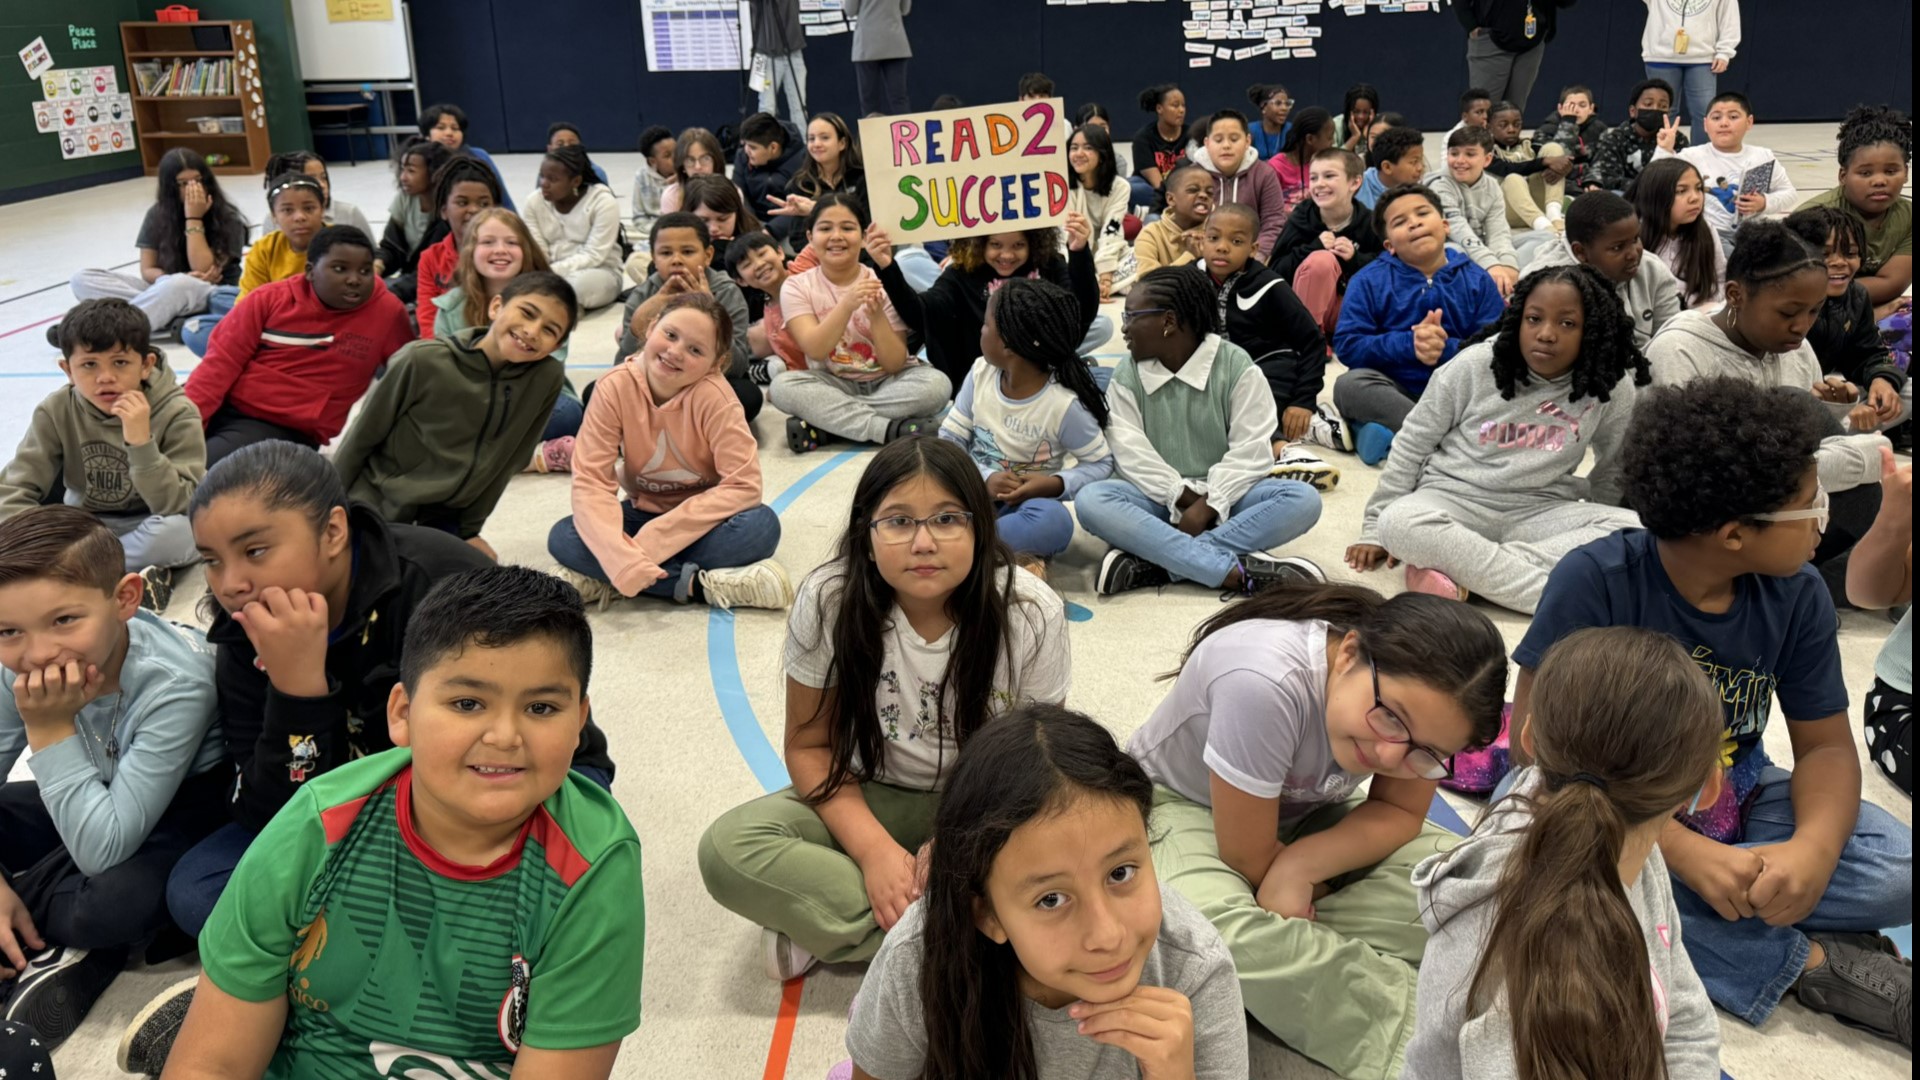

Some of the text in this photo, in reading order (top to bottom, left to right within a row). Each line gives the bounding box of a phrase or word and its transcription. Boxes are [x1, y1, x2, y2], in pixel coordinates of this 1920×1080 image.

[68, 24, 96, 36] Peace
[71, 37, 97, 50] Place
[898, 171, 1069, 231] SUCCEED
[1479, 421, 1567, 452] PUMA
[96, 470, 122, 491] NBA
